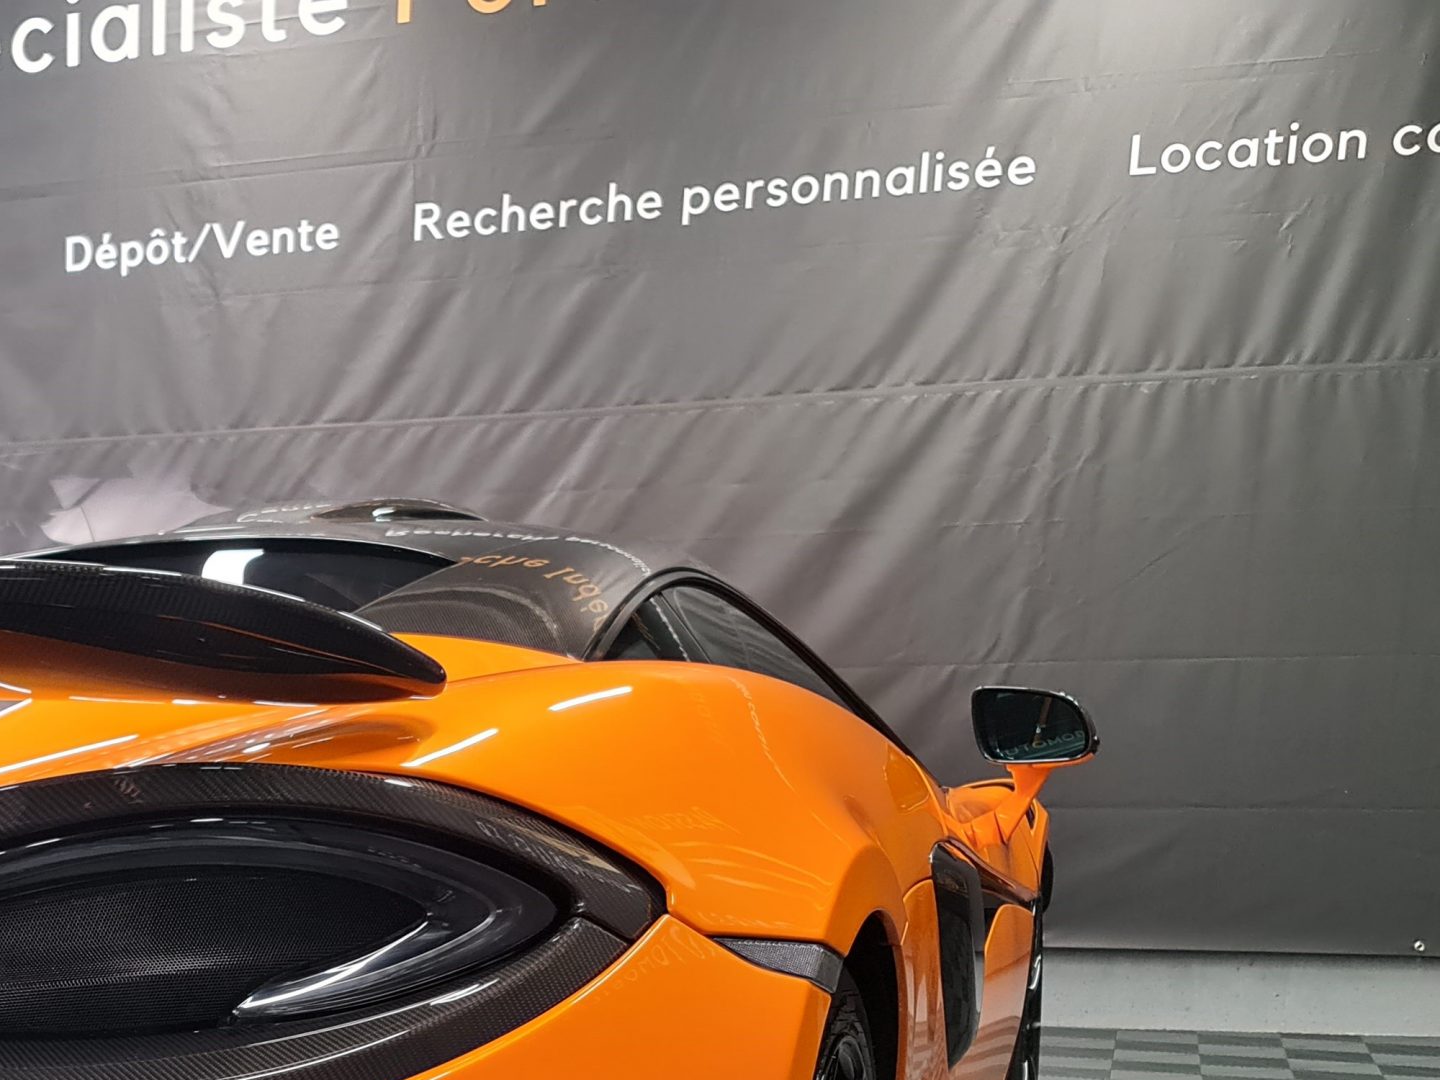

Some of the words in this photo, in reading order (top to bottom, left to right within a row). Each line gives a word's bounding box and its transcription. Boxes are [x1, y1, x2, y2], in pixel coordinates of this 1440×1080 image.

[1128, 121, 1367, 177] Location
[412, 182, 663, 243] Recherche
[681, 145, 1037, 227] personnalisée
[64, 218, 340, 277] Dépôt/Vente
